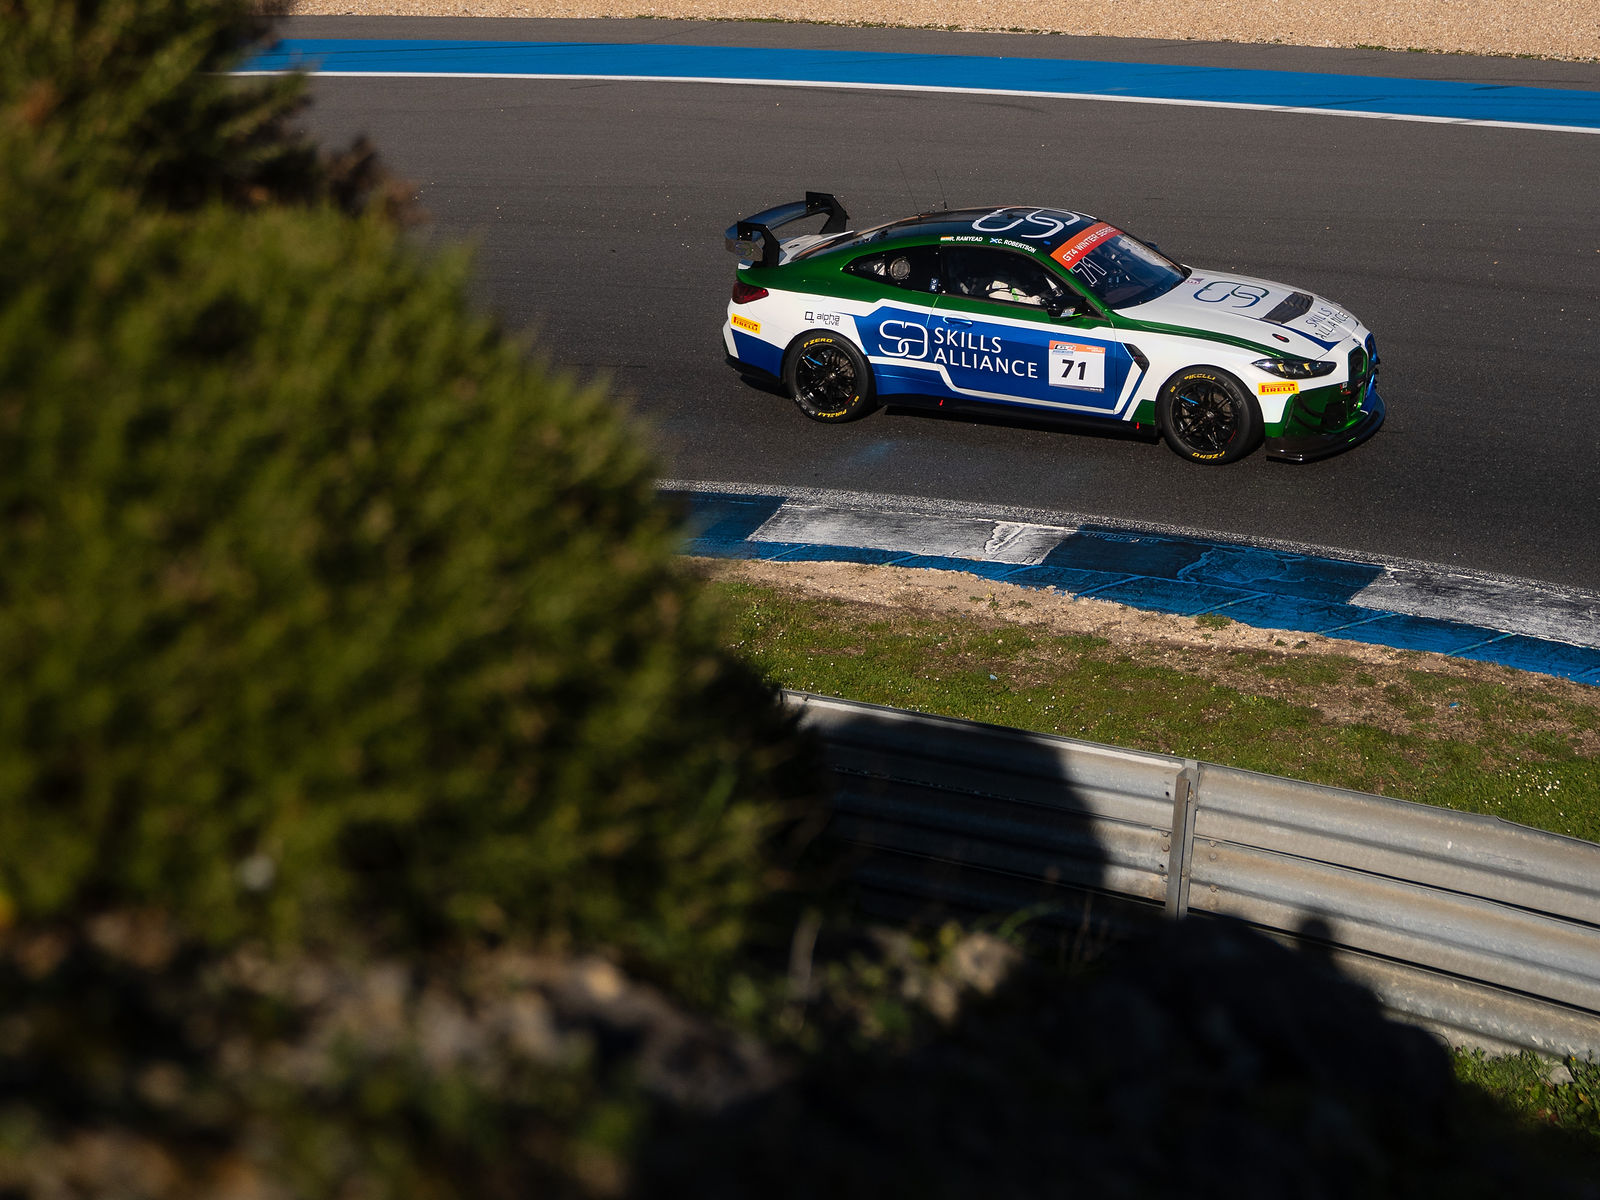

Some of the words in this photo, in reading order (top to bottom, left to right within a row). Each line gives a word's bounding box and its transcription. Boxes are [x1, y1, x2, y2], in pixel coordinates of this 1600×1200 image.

[1003, 239, 1037, 254] ROBERTSON
[1062, 248, 1079, 262] GT4
[1075, 233, 1099, 251] WINTER
[1072, 256, 1107, 285] 71
[733, 316, 759, 332] PIRELLI
[816, 313, 840, 322] alpha
[1305, 307, 1333, 328] SKILLS
[1314, 311, 1350, 340] ALLANCE
[934, 327, 1002, 354] SKILLS
[933, 347, 1039, 379] ALLIANCE
[1061, 359, 1087, 381] 71
[1261, 383, 1295, 393] PIRELLI
